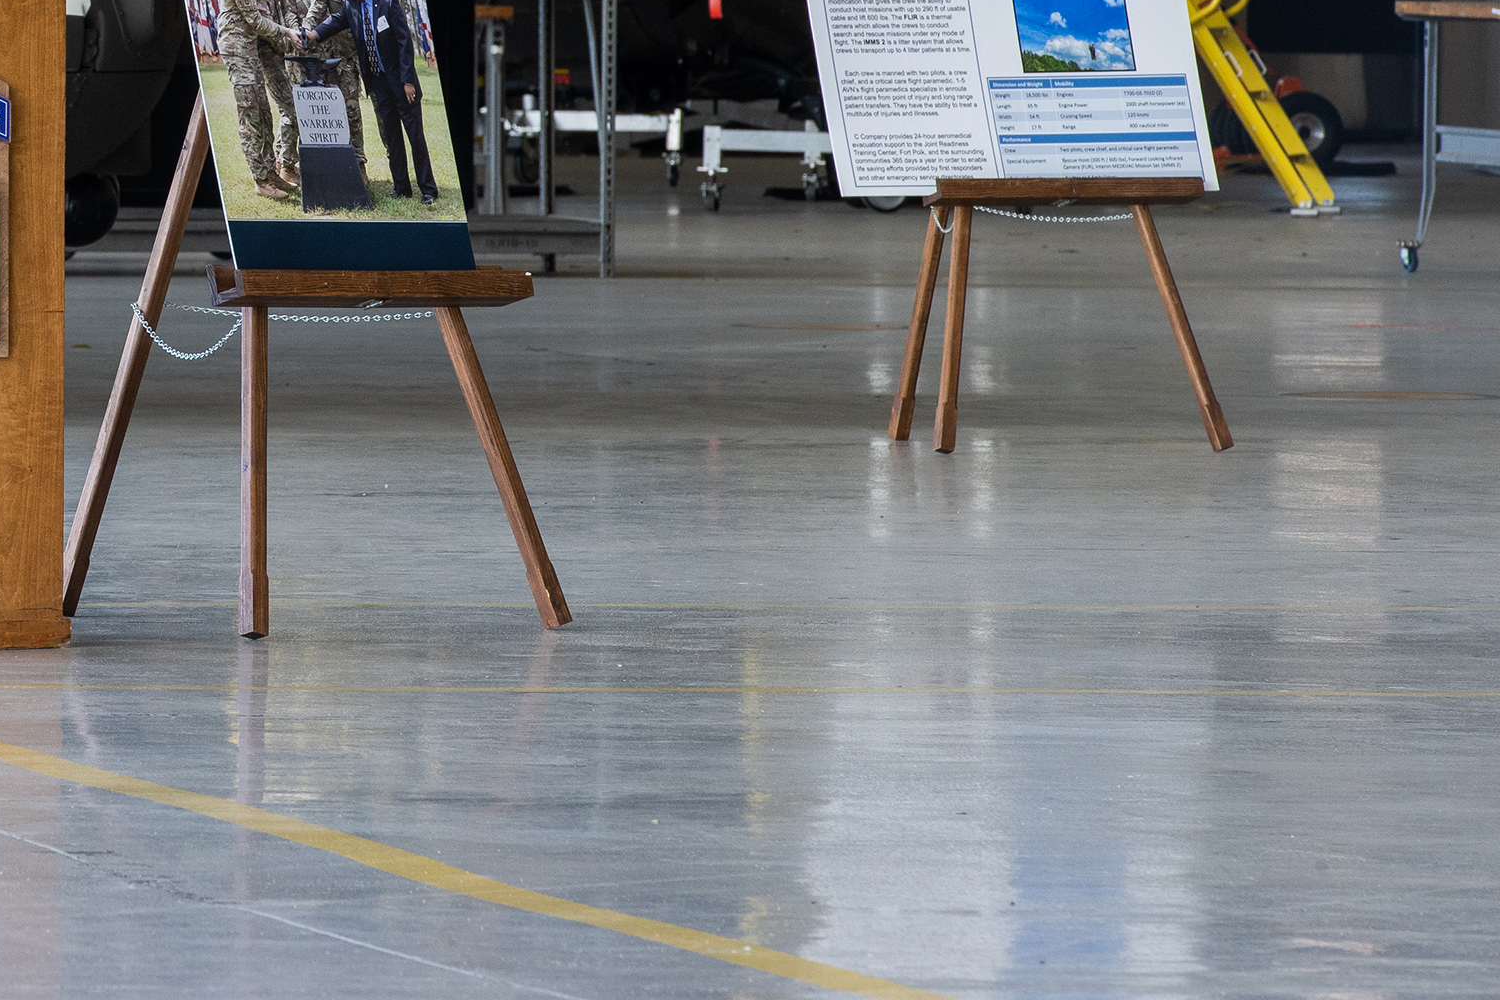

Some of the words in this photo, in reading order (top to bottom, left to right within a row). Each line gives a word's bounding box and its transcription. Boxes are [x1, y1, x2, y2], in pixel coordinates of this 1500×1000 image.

[296, 90, 338, 101] FORGING
[309, 105, 330, 114] THE
[300, 119, 344, 129] WARRIOR
[309, 133, 339, 142] SPIRIT
